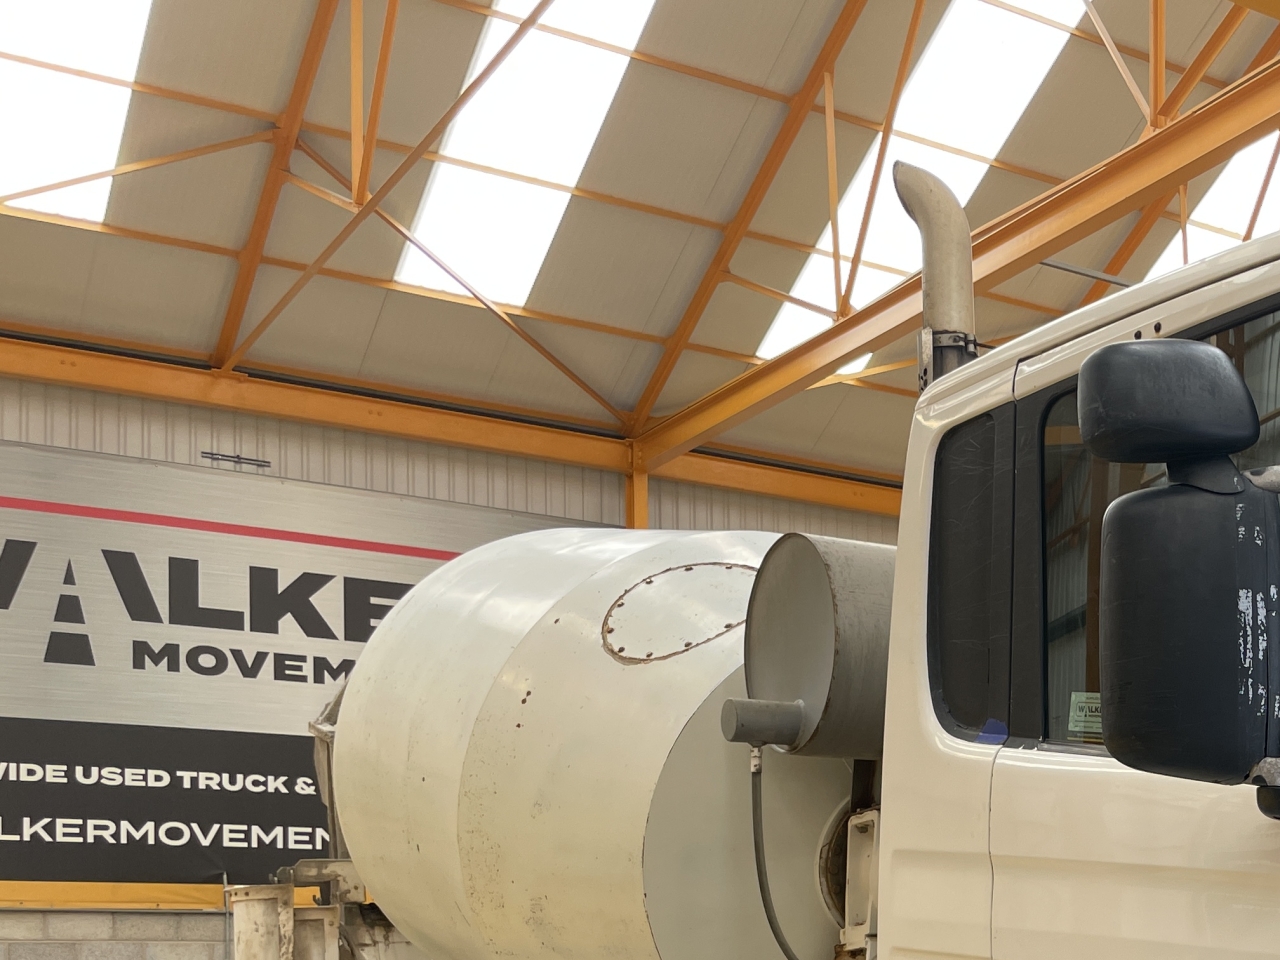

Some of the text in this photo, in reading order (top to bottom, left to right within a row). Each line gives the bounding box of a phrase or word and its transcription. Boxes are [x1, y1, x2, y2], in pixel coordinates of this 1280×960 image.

[75, 765, 171, 788] USED
[176, 770, 289, 794] TRUCK
[294, 776, 317, 795] &
